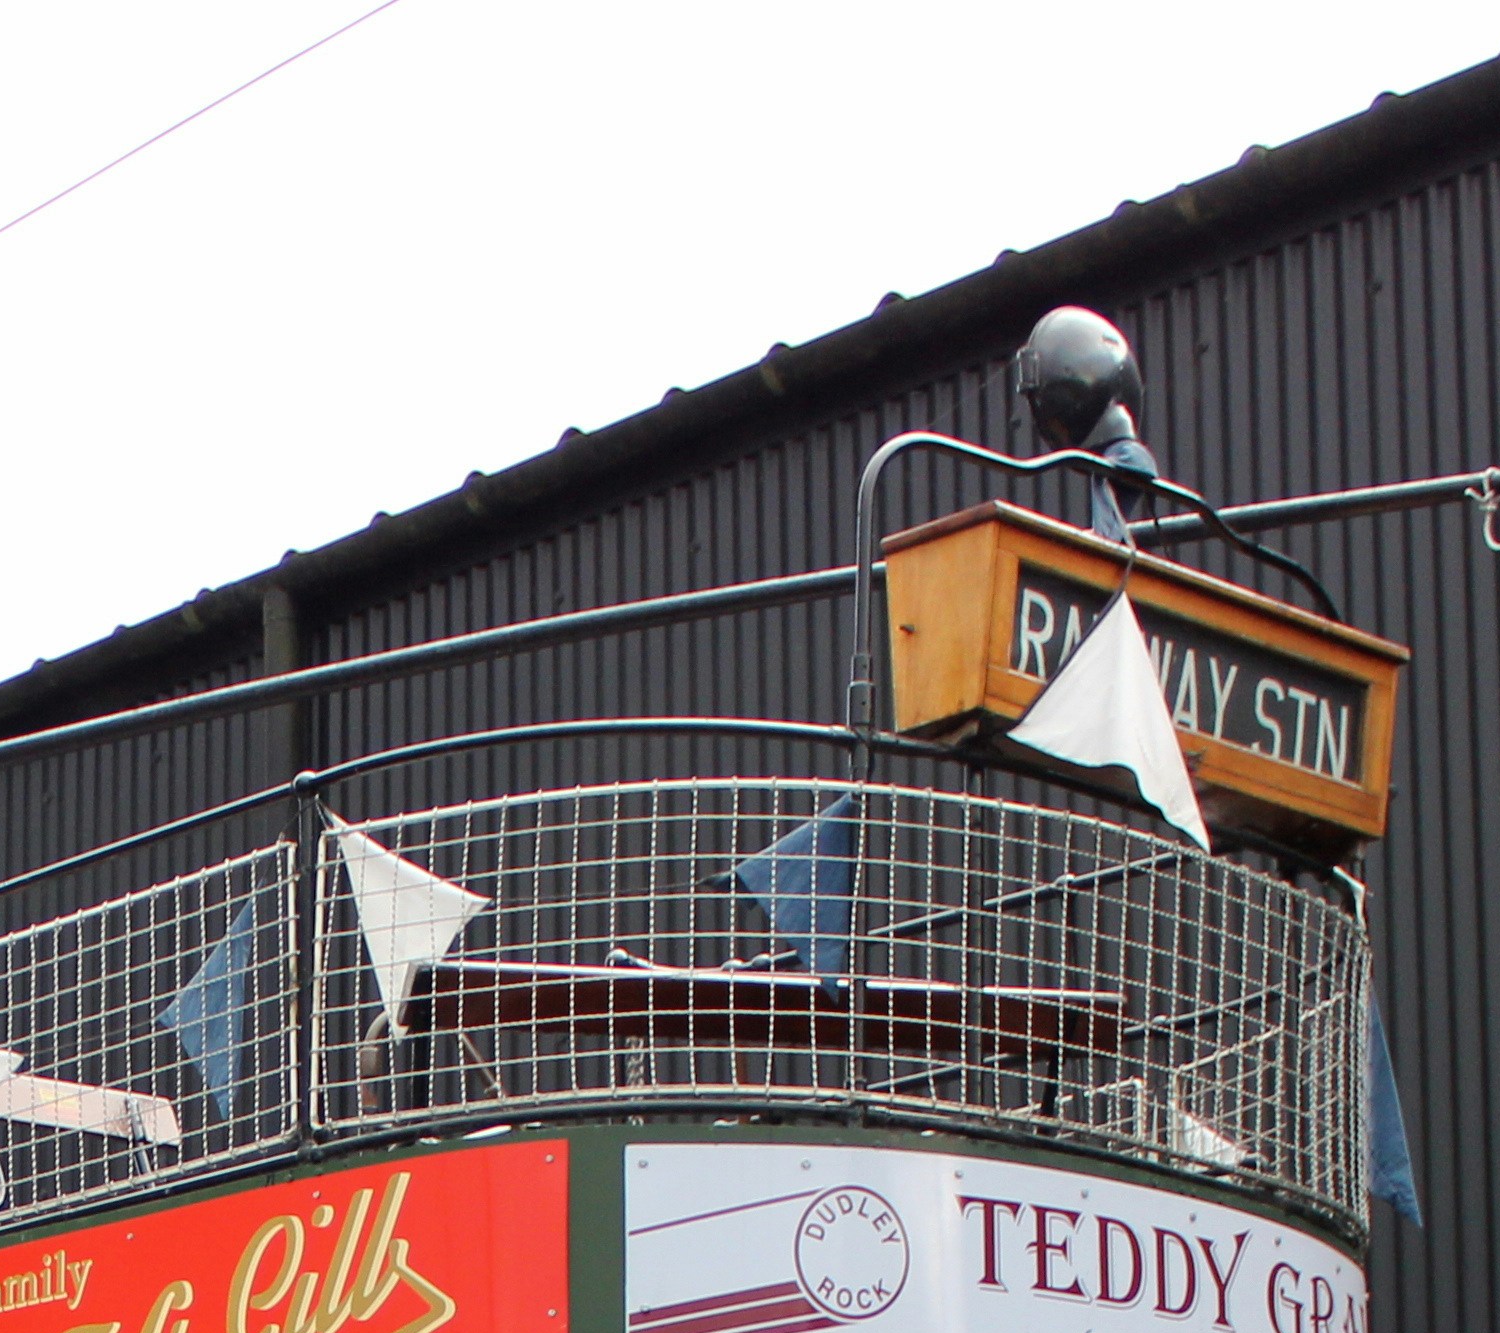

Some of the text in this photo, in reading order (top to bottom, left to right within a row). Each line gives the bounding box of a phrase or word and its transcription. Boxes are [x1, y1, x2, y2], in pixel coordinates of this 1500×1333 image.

[1253, 677, 1349, 780] STN
[804, 1194, 901, 1247] DUDLEY
[817, 1275, 891, 1310] ROCK
[955, 1195, 1252, 1333] TEDDY
